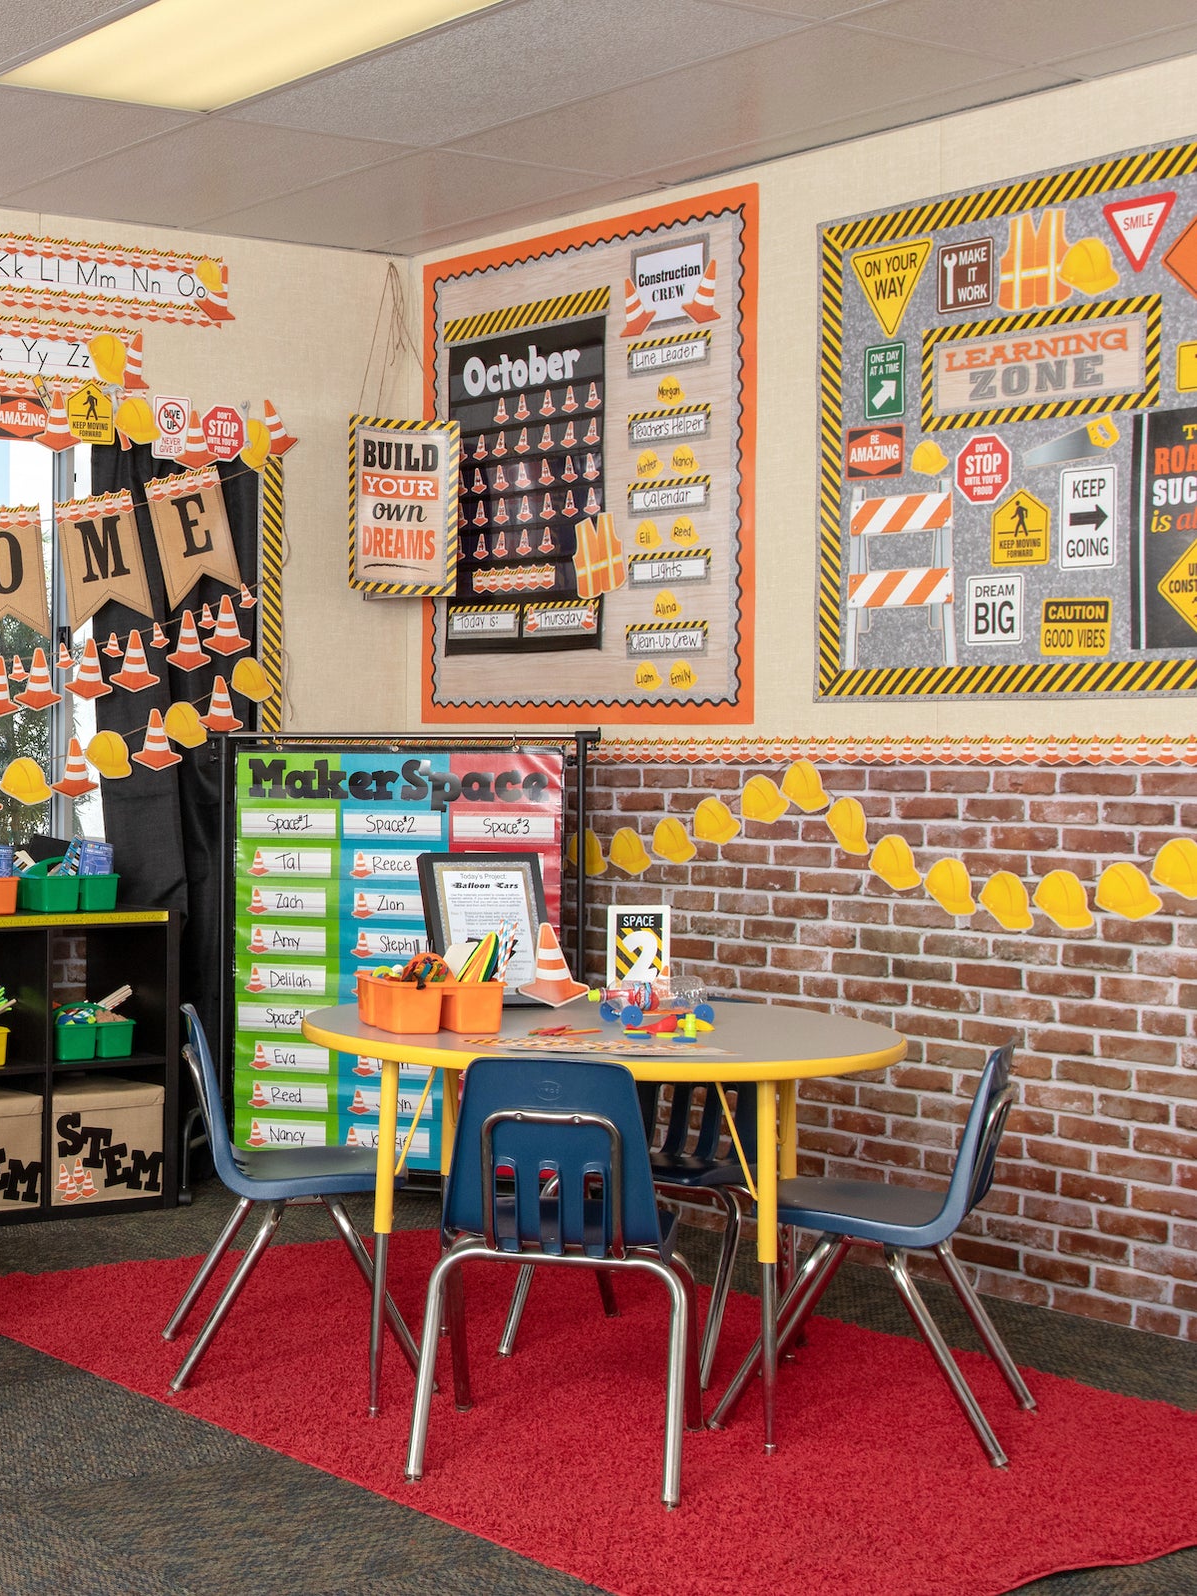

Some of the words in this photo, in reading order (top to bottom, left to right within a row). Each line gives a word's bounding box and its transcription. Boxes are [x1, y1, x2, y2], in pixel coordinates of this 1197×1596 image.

[1123, 212, 1154, 231] SMILE
[959, 247, 987, 264] MAKE
[864, 261, 881, 278] ON
[885, 253, 917, 273] YOUR
[967, 267, 976, 282] IT
[639, 264, 701, 288] Construction
[652, 284, 686, 303] CREW
[874, 275, 906, 301] WAY
[958, 285, 987, 302] WORK
[635, 351, 657, 367] Line
[661, 344, 698, 363] Leader
[871, 353, 885, 364] ONE
[886, 350, 900, 361] DAY
[945, 328, 1128, 372] LEARNING
[463, 344, 581, 397] October
[885, 363, 899, 374] TIME
[969, 354, 1103, 401] ZONE
[658, 385, 681, 400] Morgan
[18, 402, 27, 411] BE
[72, 421, 86, 430] KEEP
[87, 422, 109, 431] MOVING
[79, 429, 102, 438] FORWARD
[208, 420, 239, 438] STOP
[634, 421, 669, 439] Teacher's
[671, 417, 703, 435] Helper
[161, 437, 181, 445] NEVER
[870, 434, 879, 444] BE
[363, 439, 438, 471] BUILD
[672, 456, 695, 469] Nancy
[850, 444, 899, 463] AMAZING
[965, 453, 1002, 475] STOP
[364, 475, 436, 497] YOUR
[1072, 478, 1105, 499] KEEP
[643, 489, 691, 507] Calendar
[372, 502, 427, 523] own
[362, 525, 436, 561] DREAMS
[639, 531, 651, 544] Eli
[673, 525, 691, 537] Reed
[999, 538, 1015, 550] KEEP
[1015, 538, 1041, 549] MOVING
[1066, 537, 1109, 558] GOING
[650, 563, 682, 580] Lights
[975, 584, 1015, 598] DREAM
[537, 611, 583, 627] Thursday
[974, 600, 1015, 635] BIG
[1048, 605, 1105, 620] CAUTION
[457, 615, 484, 630] Today
[489, 616, 499, 627] is:
[672, 632, 699, 647] Crew
[1044, 629, 1074, 648] GOOD
[1076, 629, 1106, 648] VIBES
[670, 670, 691, 686] Emily
[275, 853, 301, 871] Tal
[372, 857, 412, 872] Reece
[275, 893, 304, 911] Zach
[623, 916, 655, 927] SPACE
[273, 930, 301, 950] Amy
[621, 931, 658, 984] 2
[270, 970, 311, 988] Delilah
[274, 1049, 296, 1065] Eva
[271, 1086, 302, 1104] Reed
[270, 1126, 306, 1145] Nancy
[56, 1112, 164, 1192] STEM
